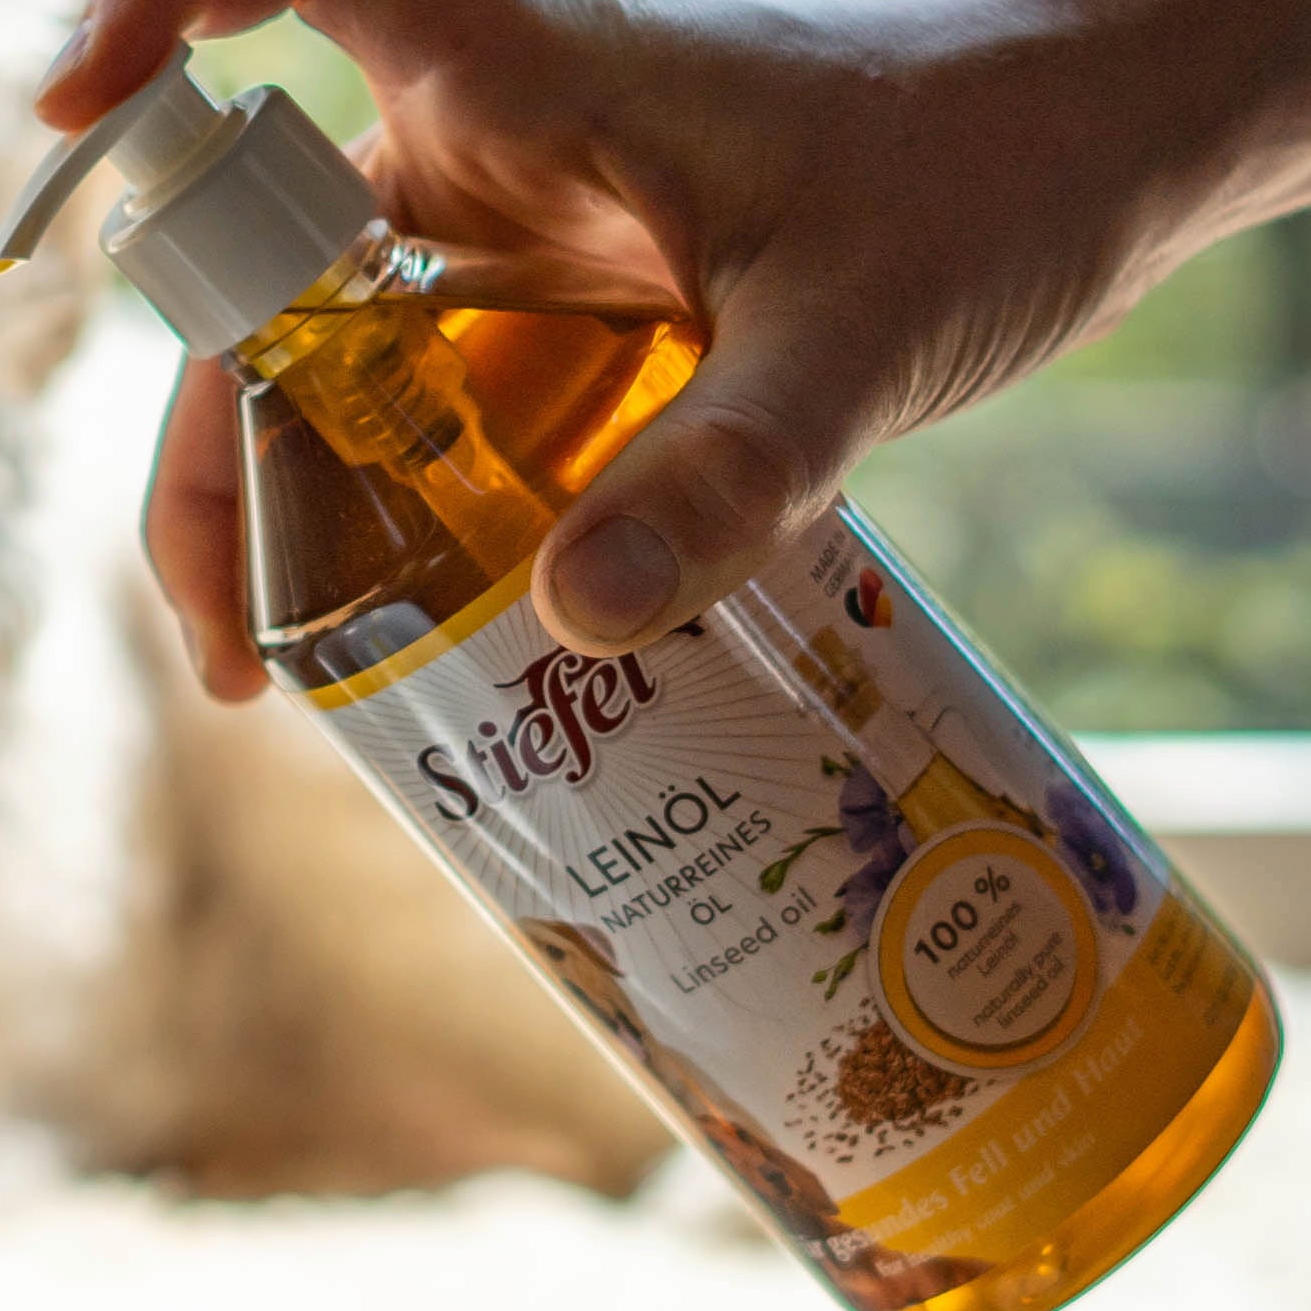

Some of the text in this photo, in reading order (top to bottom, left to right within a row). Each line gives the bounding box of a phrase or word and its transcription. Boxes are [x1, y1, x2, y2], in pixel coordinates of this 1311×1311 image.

[810, 541, 839, 583] MADE
[417, 651, 657, 821] Stiefel
[566, 776, 741, 897] LEINÖL
[601, 810, 772, 933] NATURREINES
[671, 886, 817, 993] Linseed oil
[687, 895, 733, 925] ÖL
[914, 865, 1010, 964] 100 %
[947, 1142, 1009, 1197] Fell
[1012, 1091, 1074, 1153] und
